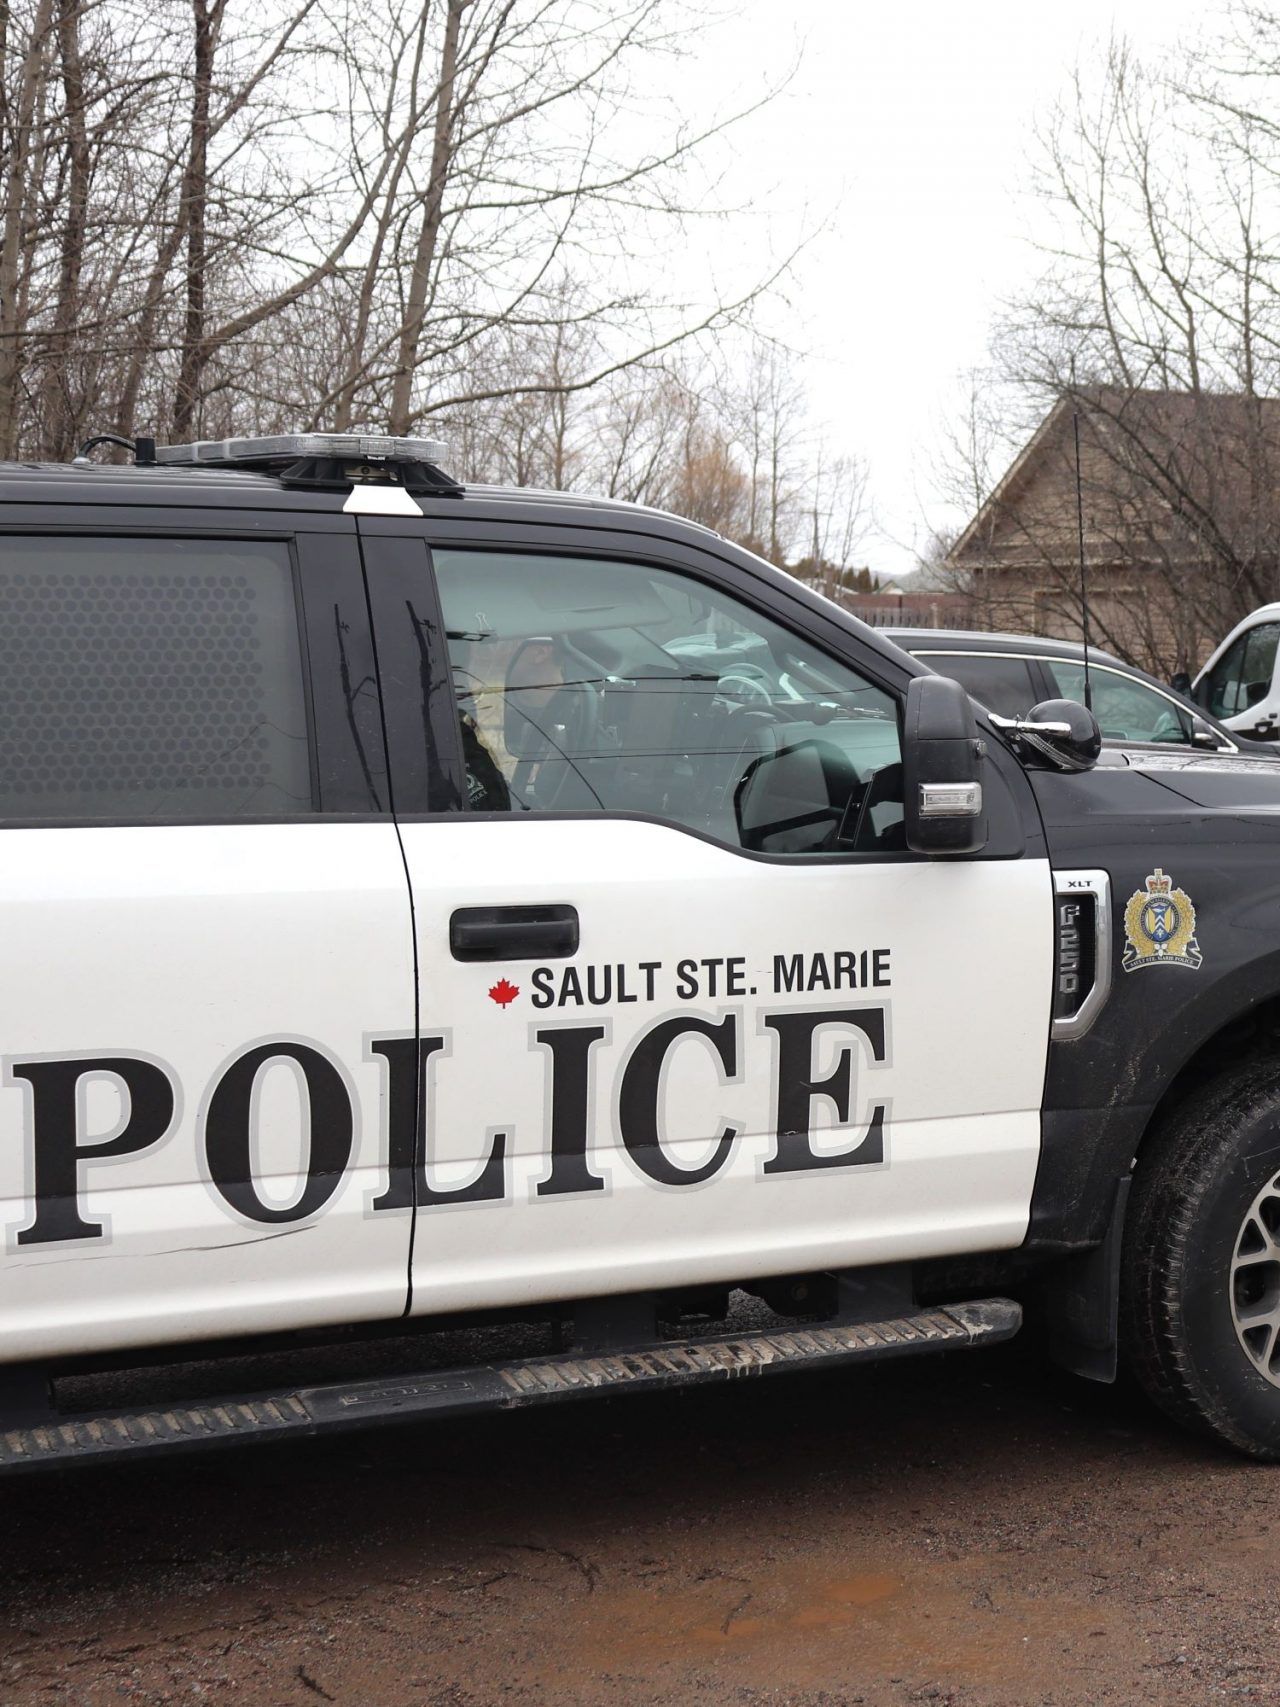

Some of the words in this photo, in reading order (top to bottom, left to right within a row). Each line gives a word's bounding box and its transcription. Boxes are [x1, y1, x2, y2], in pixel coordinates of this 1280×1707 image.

[1067, 880, 1093, 888] XLT
[530, 960, 663, 1009] SAULT
[675, 956, 758, 1001] STE.
[773, 948, 892, 994] MARIE
[1059, 903, 1081, 994] F250
[10, 1003, 890, 1248] POLICE
